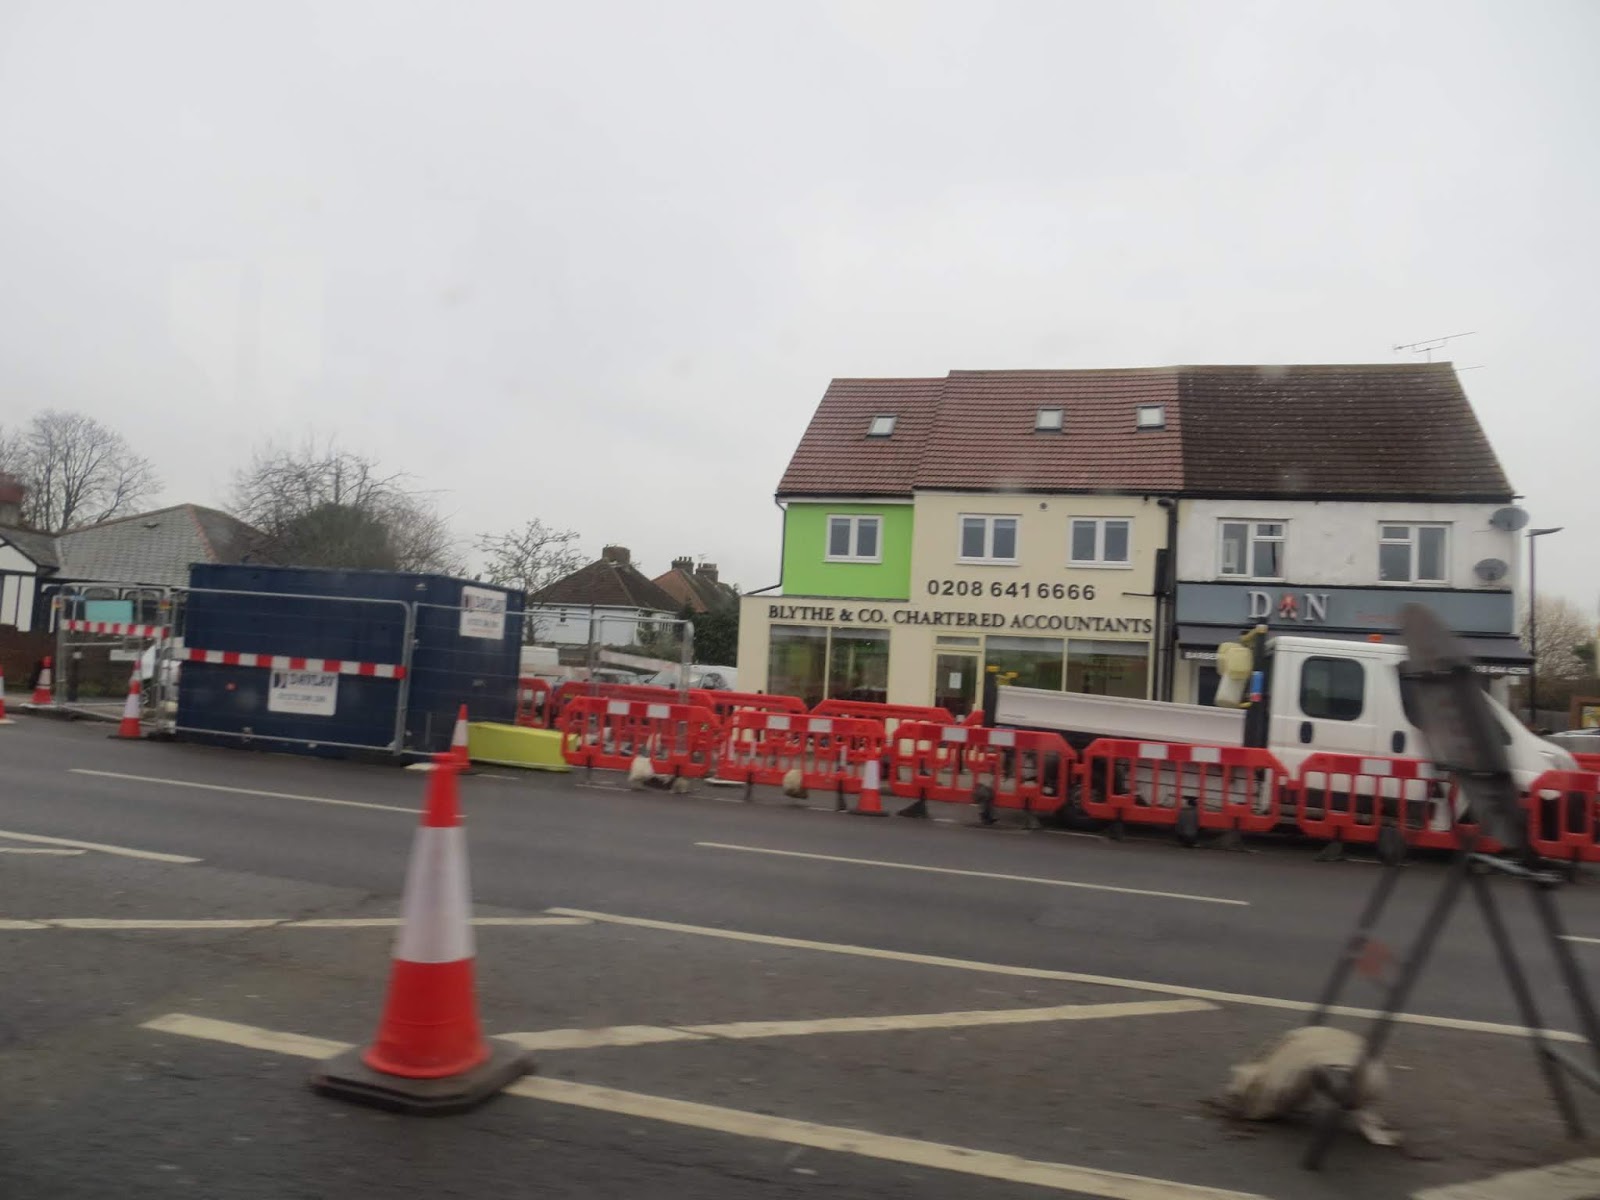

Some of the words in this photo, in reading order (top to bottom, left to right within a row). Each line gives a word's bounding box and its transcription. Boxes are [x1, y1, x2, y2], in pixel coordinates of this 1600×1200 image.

[927, 579, 983, 597] 0208
[990, 582, 1031, 598] 641
[1036, 583, 1096, 601] 6666
[768, 604, 835, 622] BLYTHE
[839, 608, 854, 622] &
[858, 608, 888, 624] CO.
[893, 609, 1006, 628] CHARTERED
[1010, 614, 1153, 634] ACCOUNTANTS
